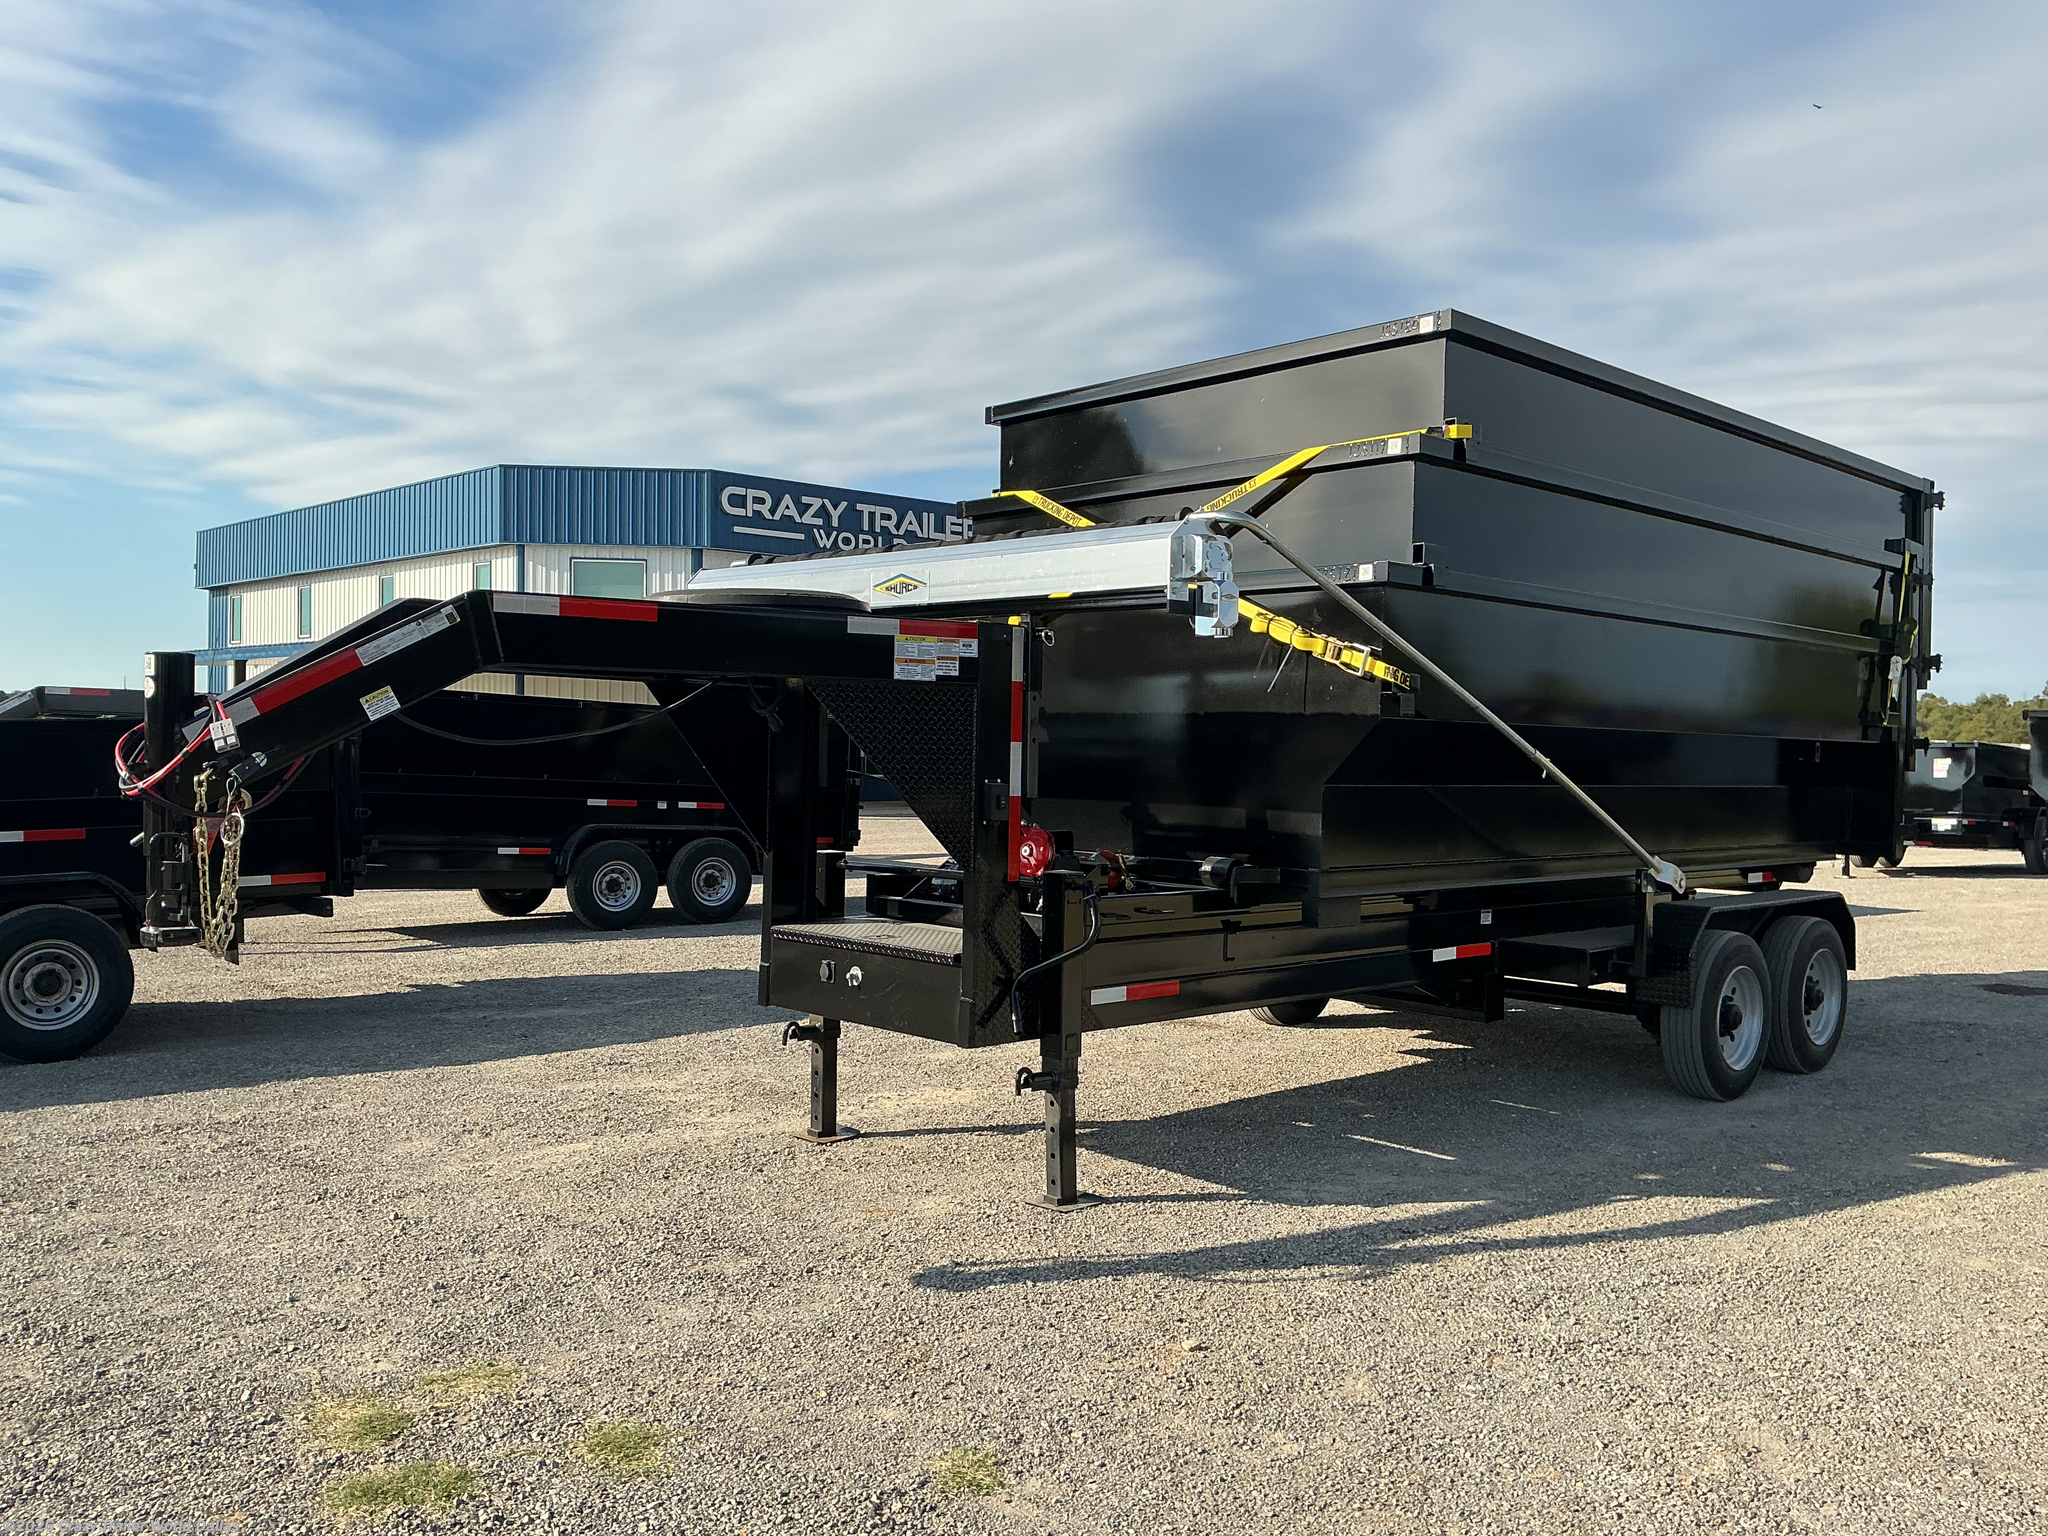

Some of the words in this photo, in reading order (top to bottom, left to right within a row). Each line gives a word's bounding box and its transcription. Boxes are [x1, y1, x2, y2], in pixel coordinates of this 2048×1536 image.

[720, 486, 847, 527] CRAZY
[1038, 496, 1063, 517] TRUCKING
[1062, 510, 1082, 527] DEPOT
[369, 689, 389, 701] CAUTION
